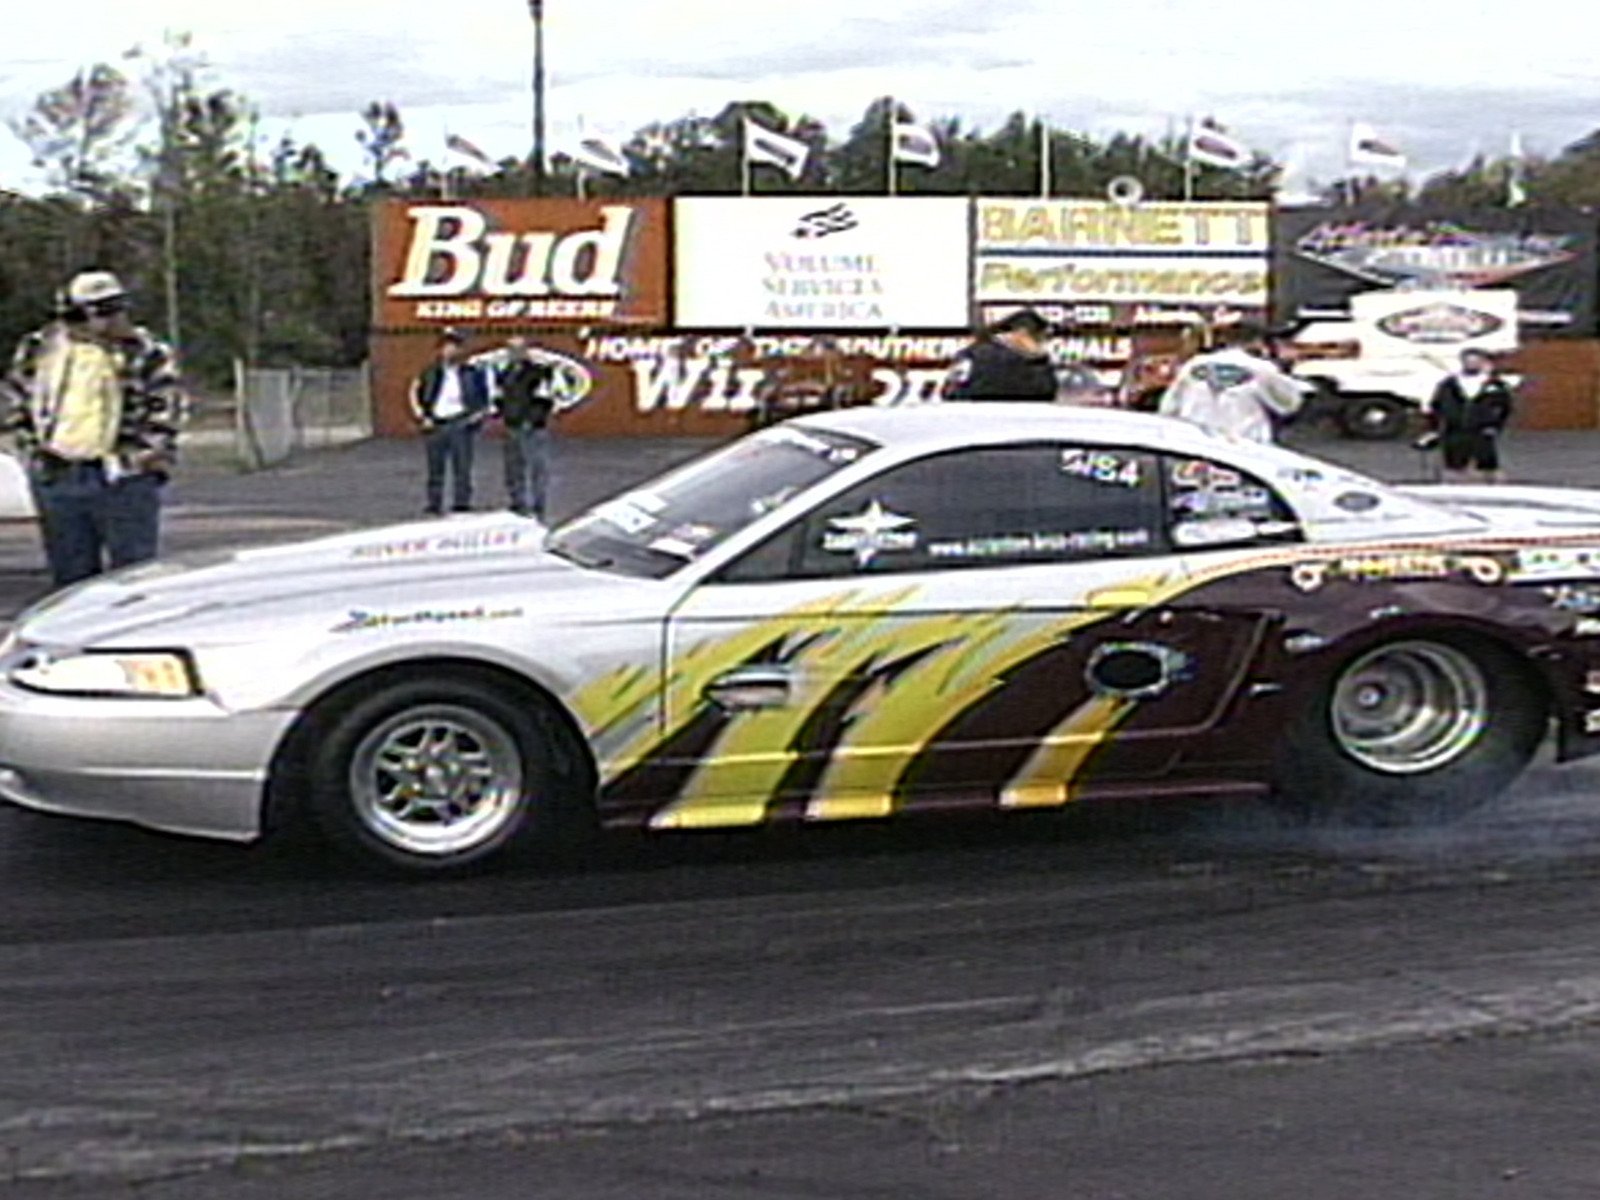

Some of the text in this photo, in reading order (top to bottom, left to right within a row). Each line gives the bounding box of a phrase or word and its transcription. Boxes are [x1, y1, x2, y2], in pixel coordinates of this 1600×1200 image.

[982, 205, 1267, 246] BARNETT
[387, 205, 634, 297] Bud
[763, 251, 881, 274] VOLUME
[762, 277, 884, 297] SERVICES
[980, 262, 1264, 295] Performance
[416, 301, 483, 318] KING
[486, 301, 526, 318] OF
[764, 300, 884, 320] AMERICA
[585, 336, 683, 361] HOME
